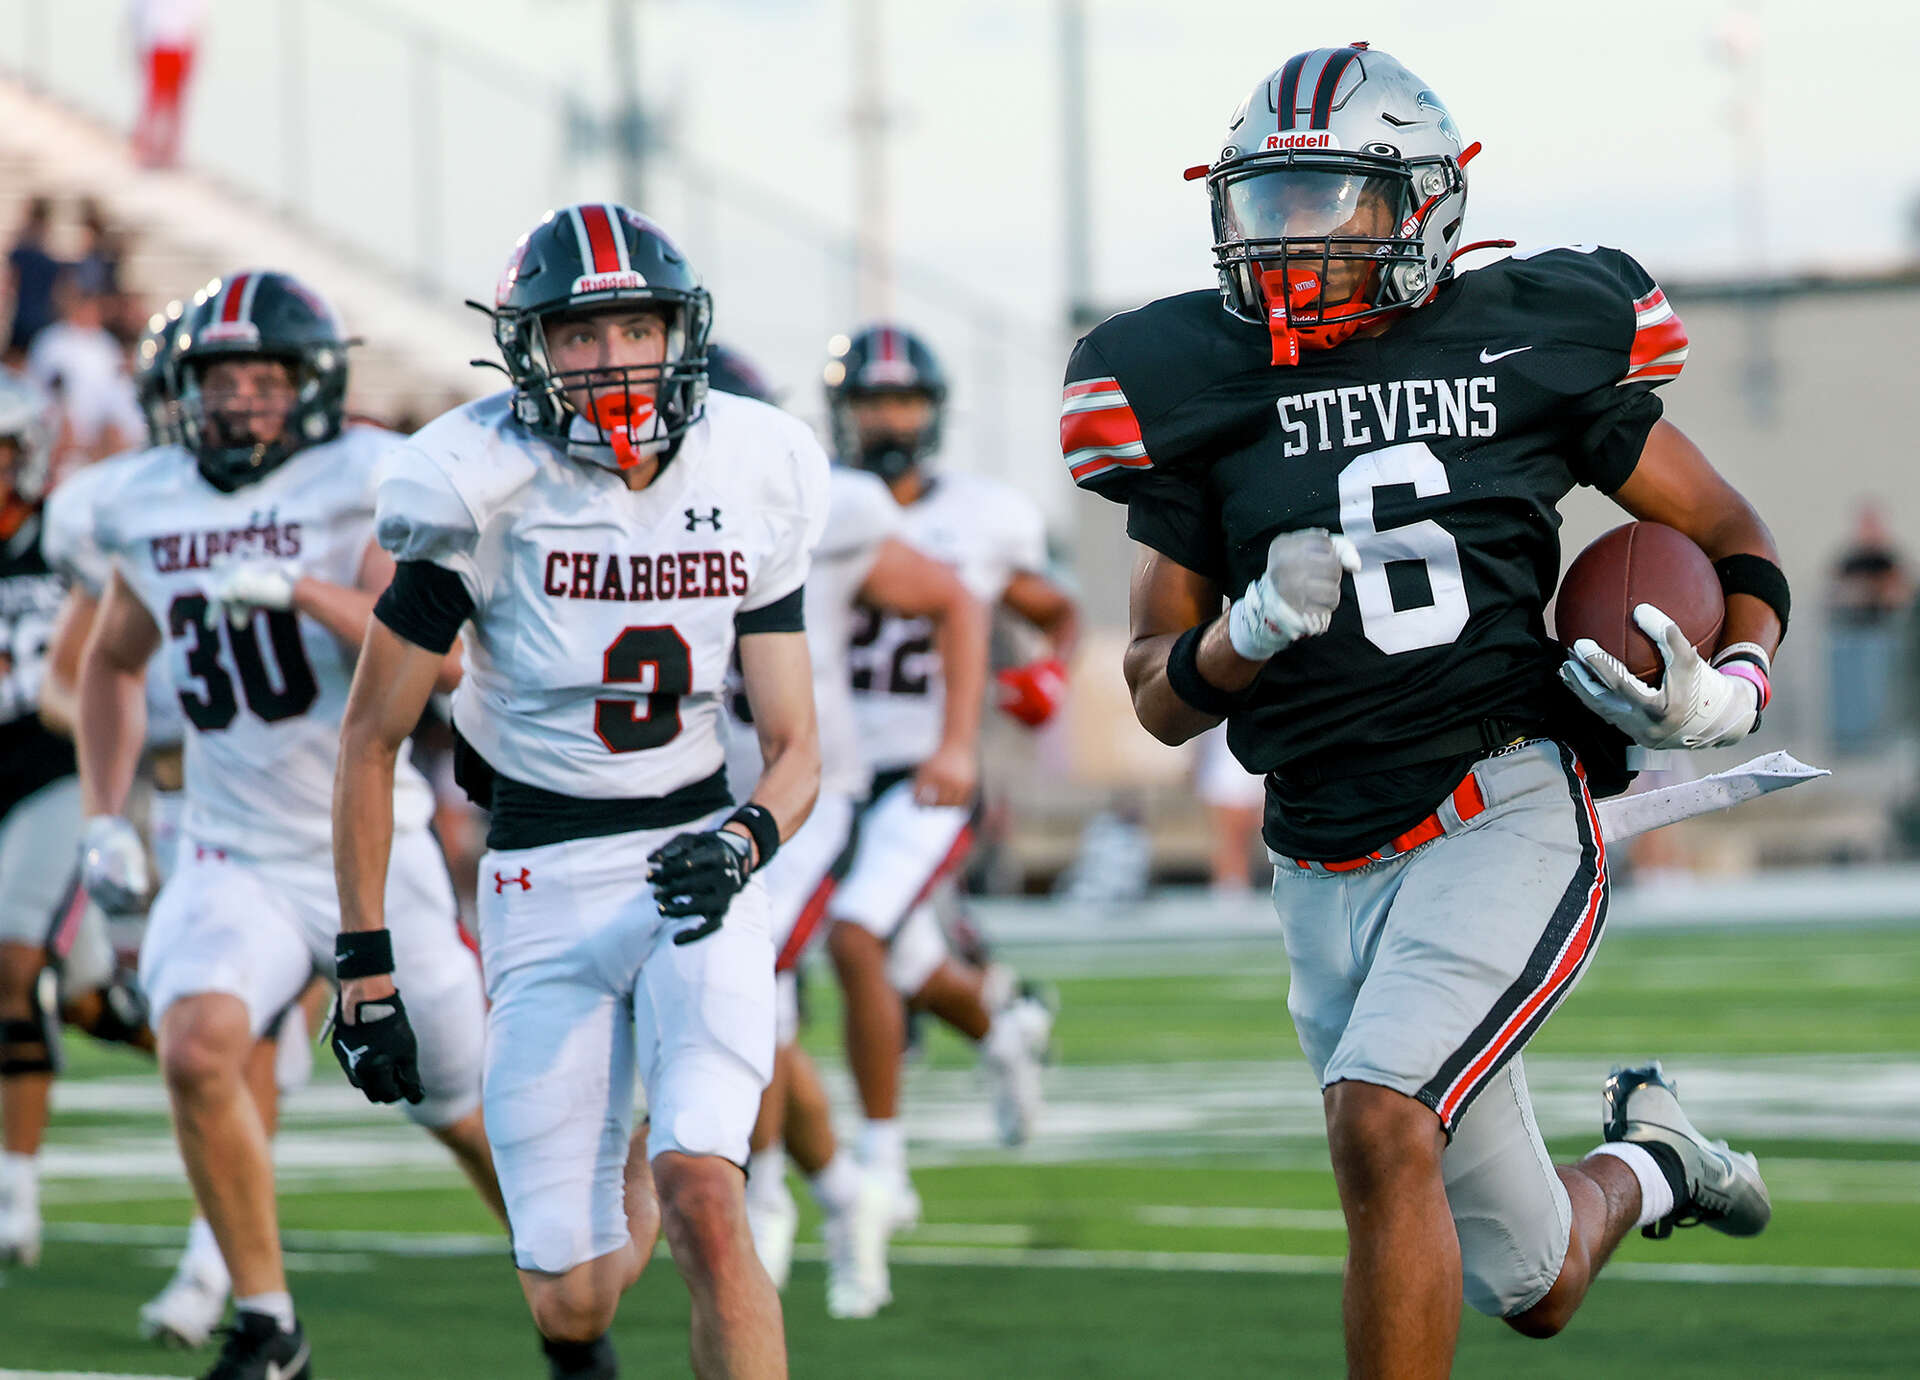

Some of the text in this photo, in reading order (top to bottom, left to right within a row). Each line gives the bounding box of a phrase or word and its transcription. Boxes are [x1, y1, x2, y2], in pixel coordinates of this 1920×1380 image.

[1266, 134, 1330, 149] Riddell
[1276, 376, 1497, 458] STEVENS
[544, 550, 749, 601] CHARGERS
[1337, 441, 1471, 656] 6
[169, 588, 320, 732] 30
[593, 624, 693, 754] 3
